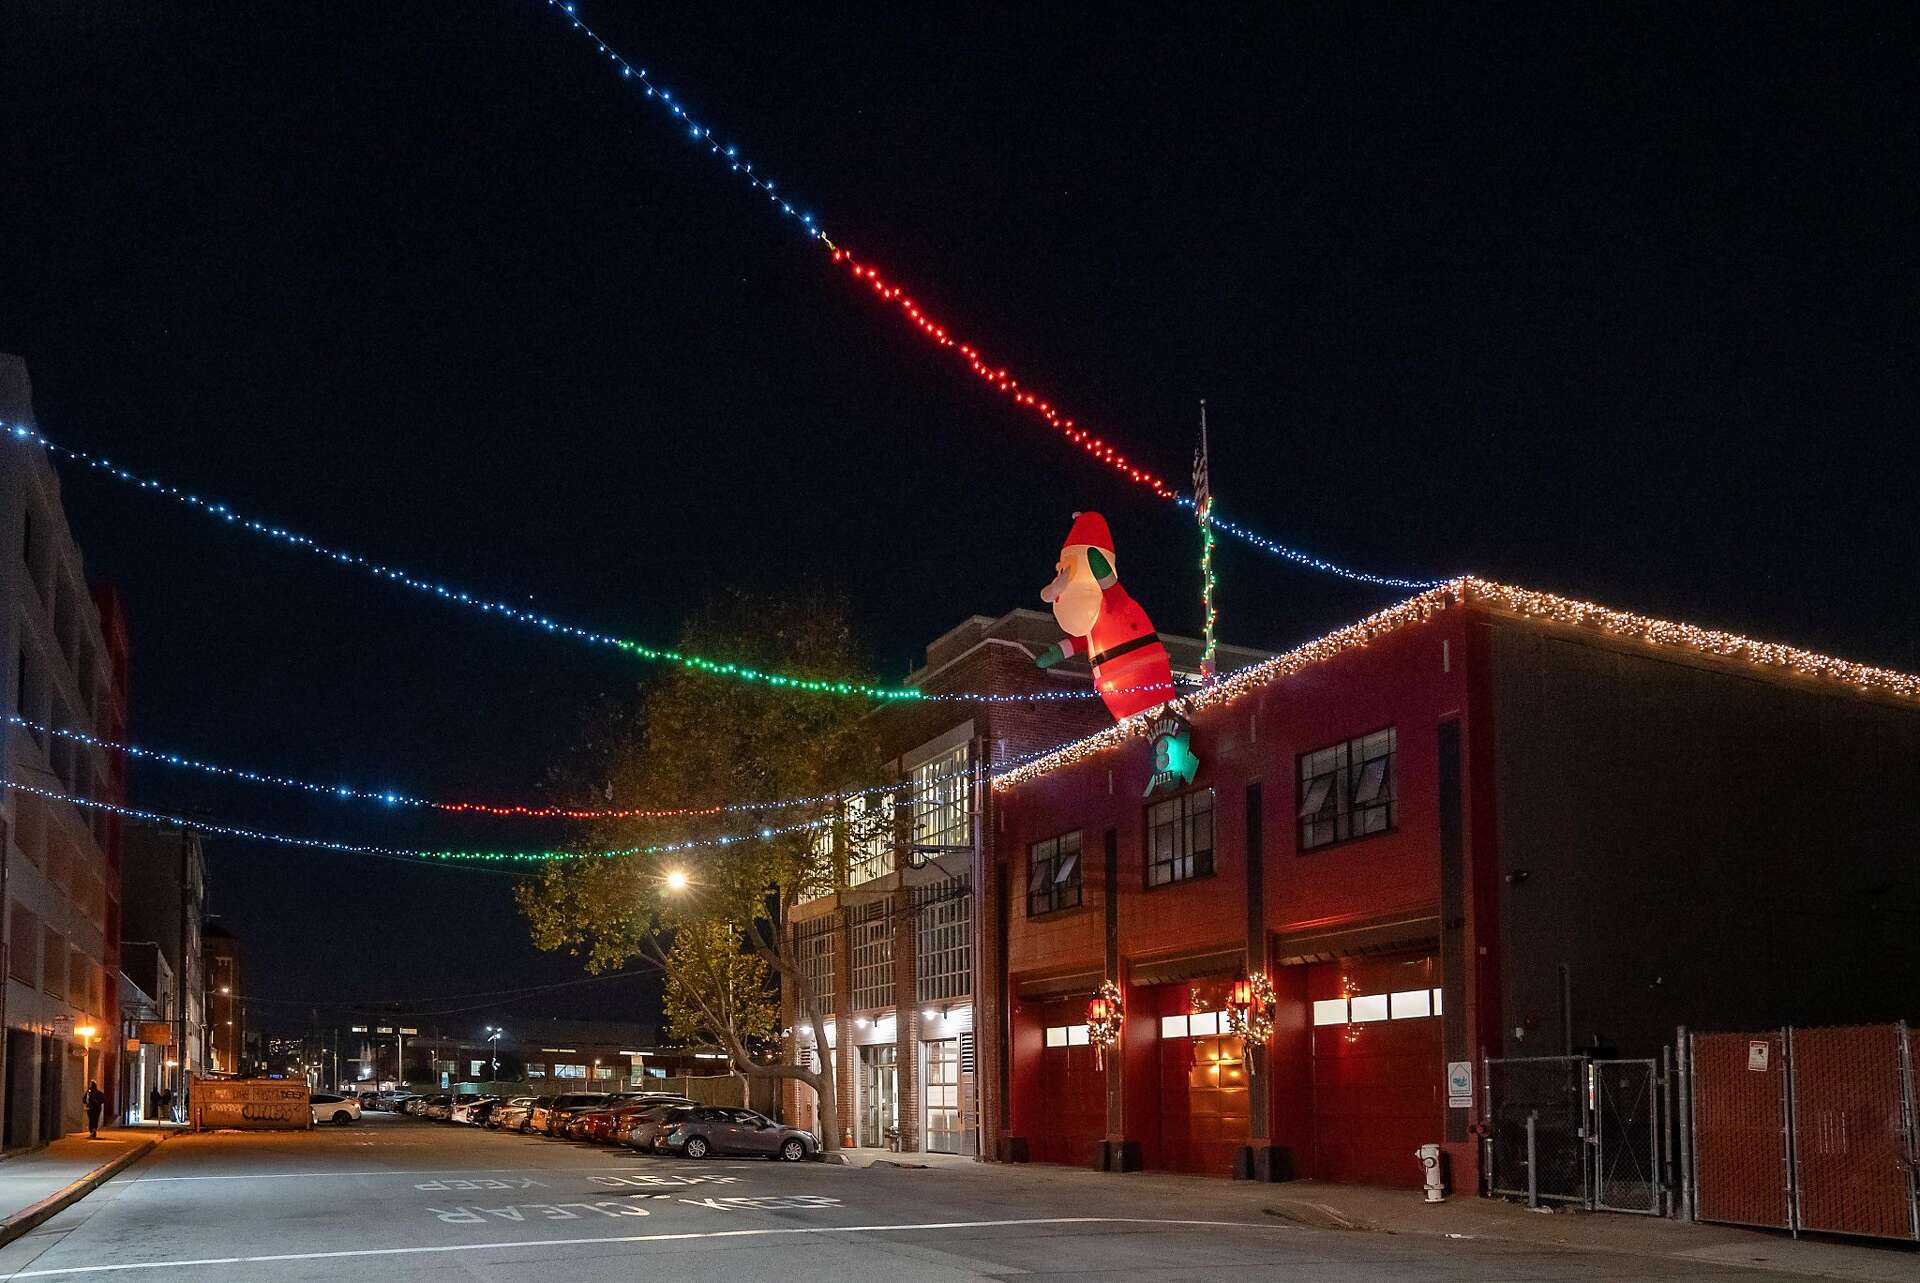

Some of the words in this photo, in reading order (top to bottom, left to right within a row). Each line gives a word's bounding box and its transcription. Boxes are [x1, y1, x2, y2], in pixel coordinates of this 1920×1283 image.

[1156, 739, 1169, 770] 8
[413, 1178, 549, 1191] KEEP
[586, 1174, 749, 1186] CLEAR
[678, 1195, 847, 1211] KEEP
[426, 1202, 650, 1224] CLEAR
